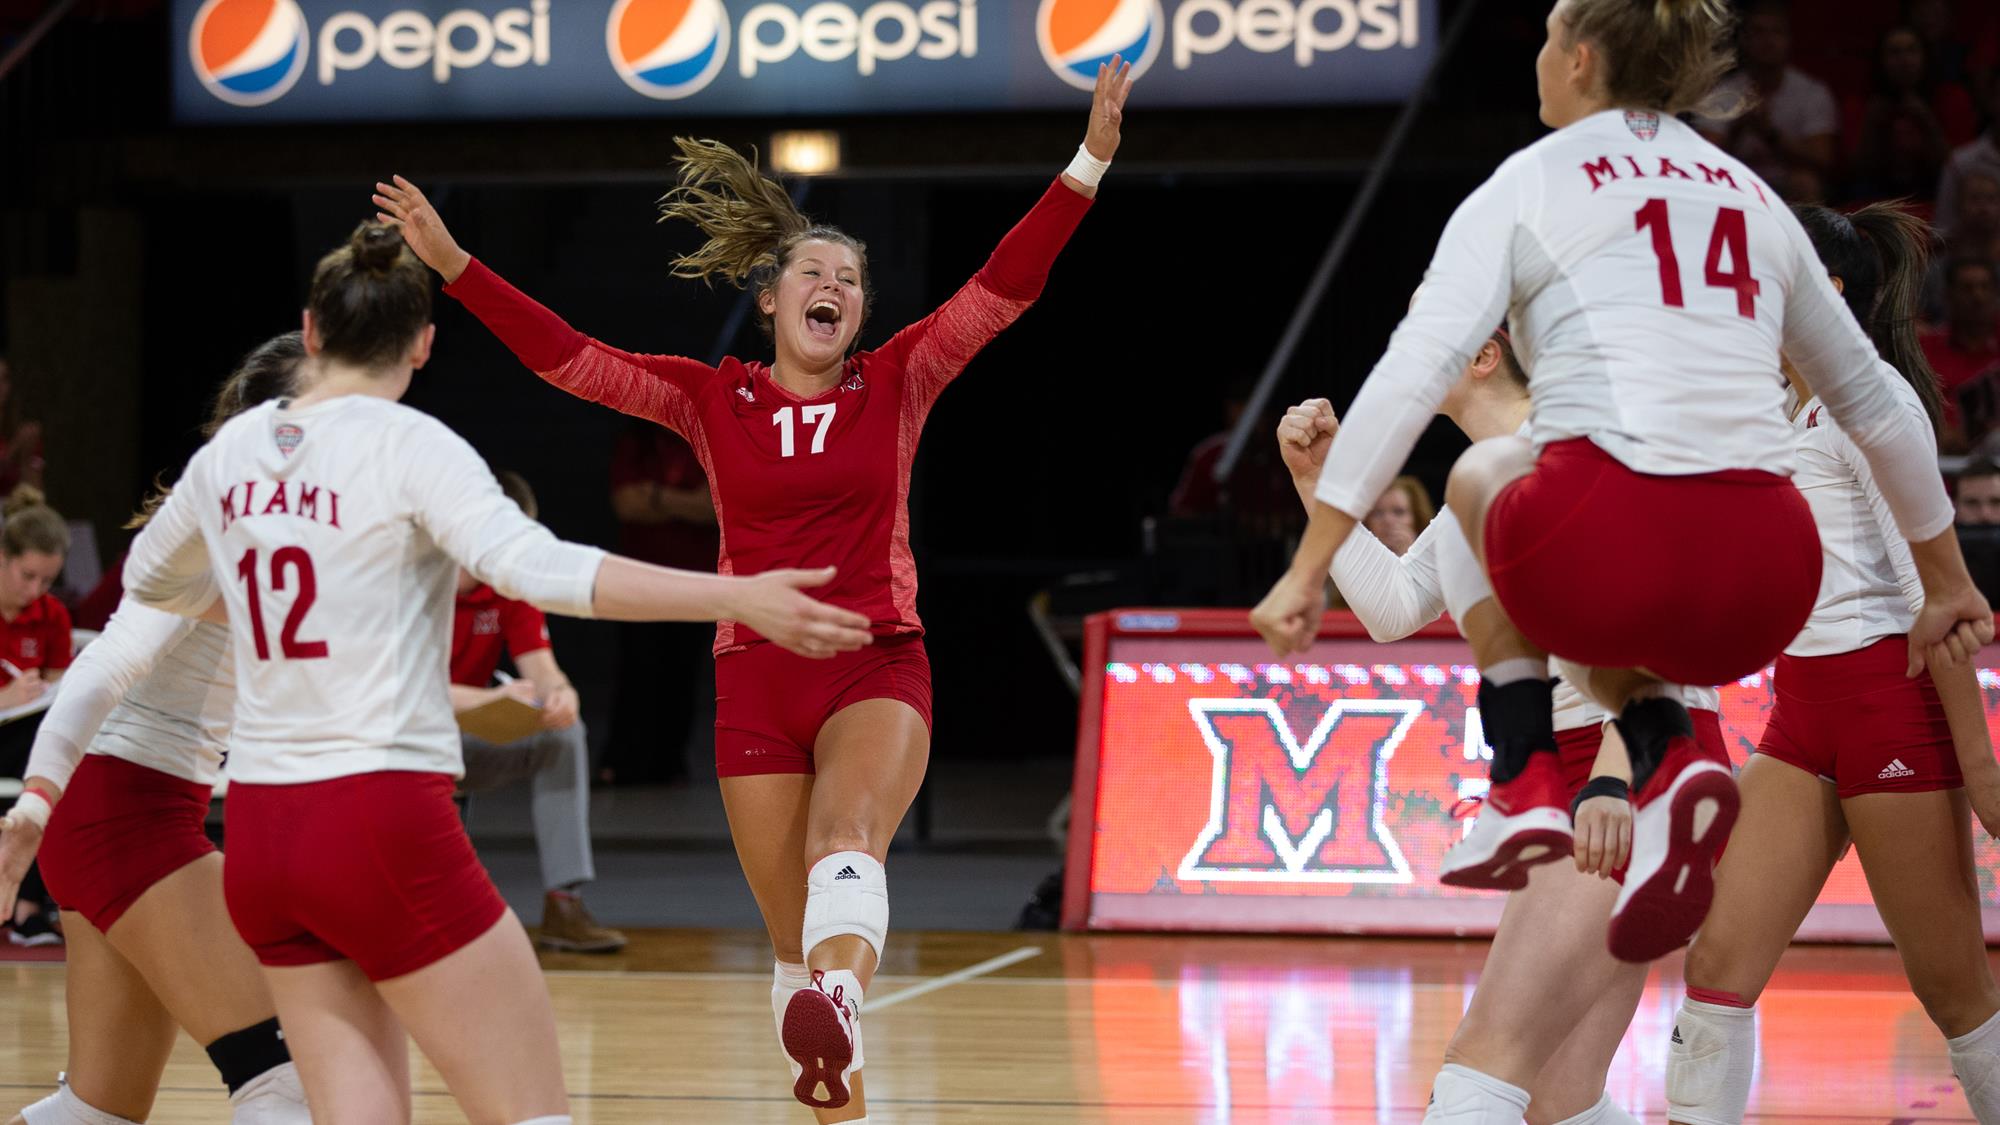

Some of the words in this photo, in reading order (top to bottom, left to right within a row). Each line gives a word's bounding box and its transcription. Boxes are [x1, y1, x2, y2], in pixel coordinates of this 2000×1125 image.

[319, 0, 551, 84] pepsi
[739, 0, 978, 78] pepsi
[1172, 0, 1418, 69] pepsi
[1580, 155, 1770, 208] MIAMI
[1634, 197, 1761, 320] 14
[772, 402, 837, 457] 17
[219, 480, 343, 534] MIAMI
[237, 545, 329, 661] 12
[1177, 698, 1425, 884] M
[1878, 768, 1915, 779] adidas
